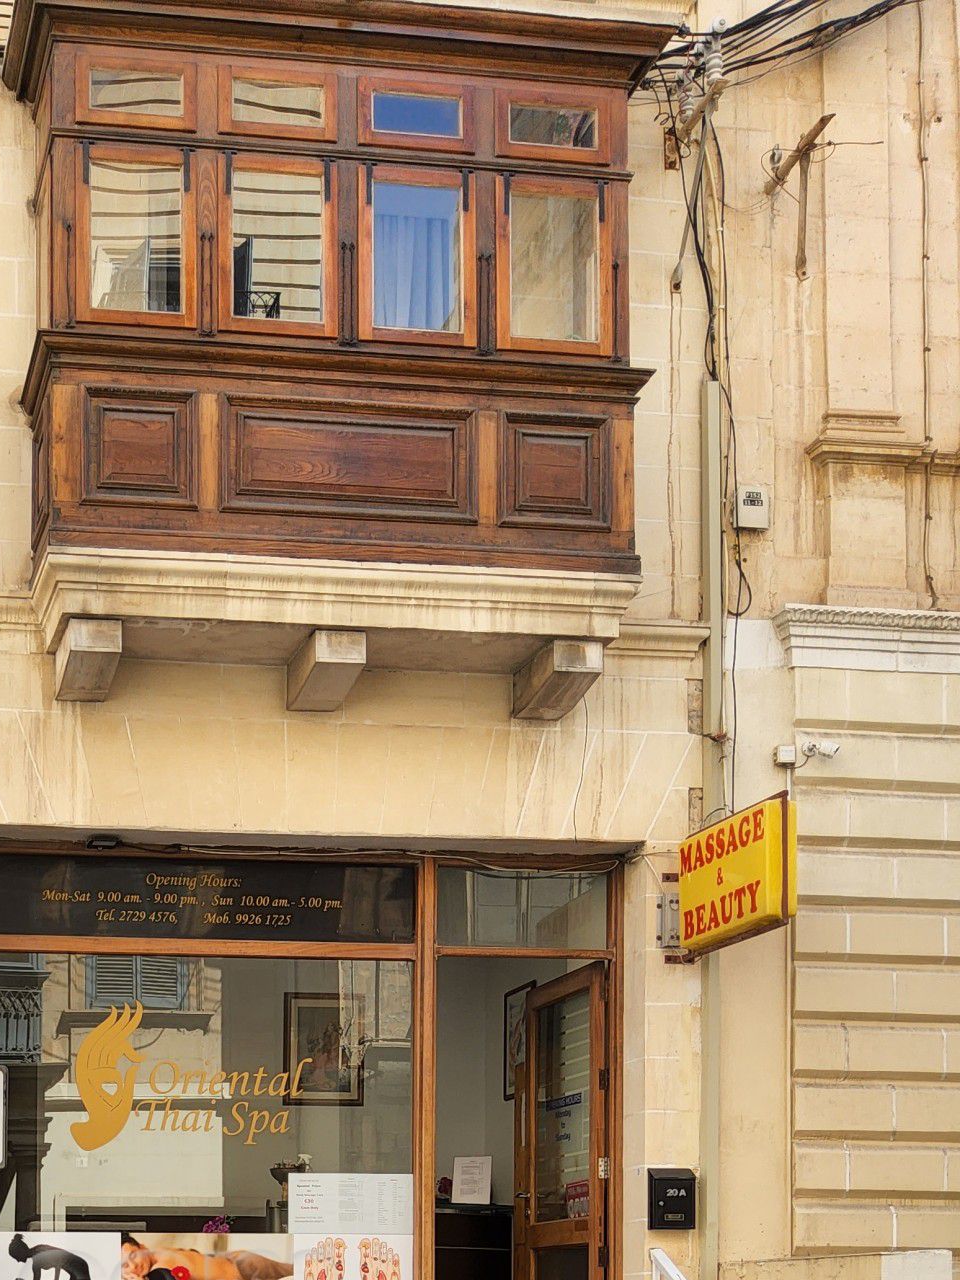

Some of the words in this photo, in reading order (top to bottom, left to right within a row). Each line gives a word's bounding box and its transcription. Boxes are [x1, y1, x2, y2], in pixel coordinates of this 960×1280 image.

[680, 808, 765, 877] MASSAGE
[146, 873, 197, 890] Opening
[200, 873, 242, 888] Hours:
[716, 867, 723, 885] &
[42, 889, 91, 903] Mon-Sat
[97, 891, 121, 903] 9.00
[154, 893, 177, 904] 9.00
[211, 895, 233, 906] Sun
[240, 896, 270, 907] 10.00
[298, 897, 322, 908] 5.00
[323, 901, 343, 912] pm.
[684, 880, 761, 941] BEAUTY
[95, 909, 115, 921] Tel.
[119, 911, 146, 922] 2729
[149, 911, 178, 924] 4576,
[203, 912, 231, 924] Mob.
[235, 914, 262, 925] 9926
[149, 1057, 313, 1097] Oriental
[134, 1096, 215, 1132] Thai
[222, 1101, 290, 1145] Spa
